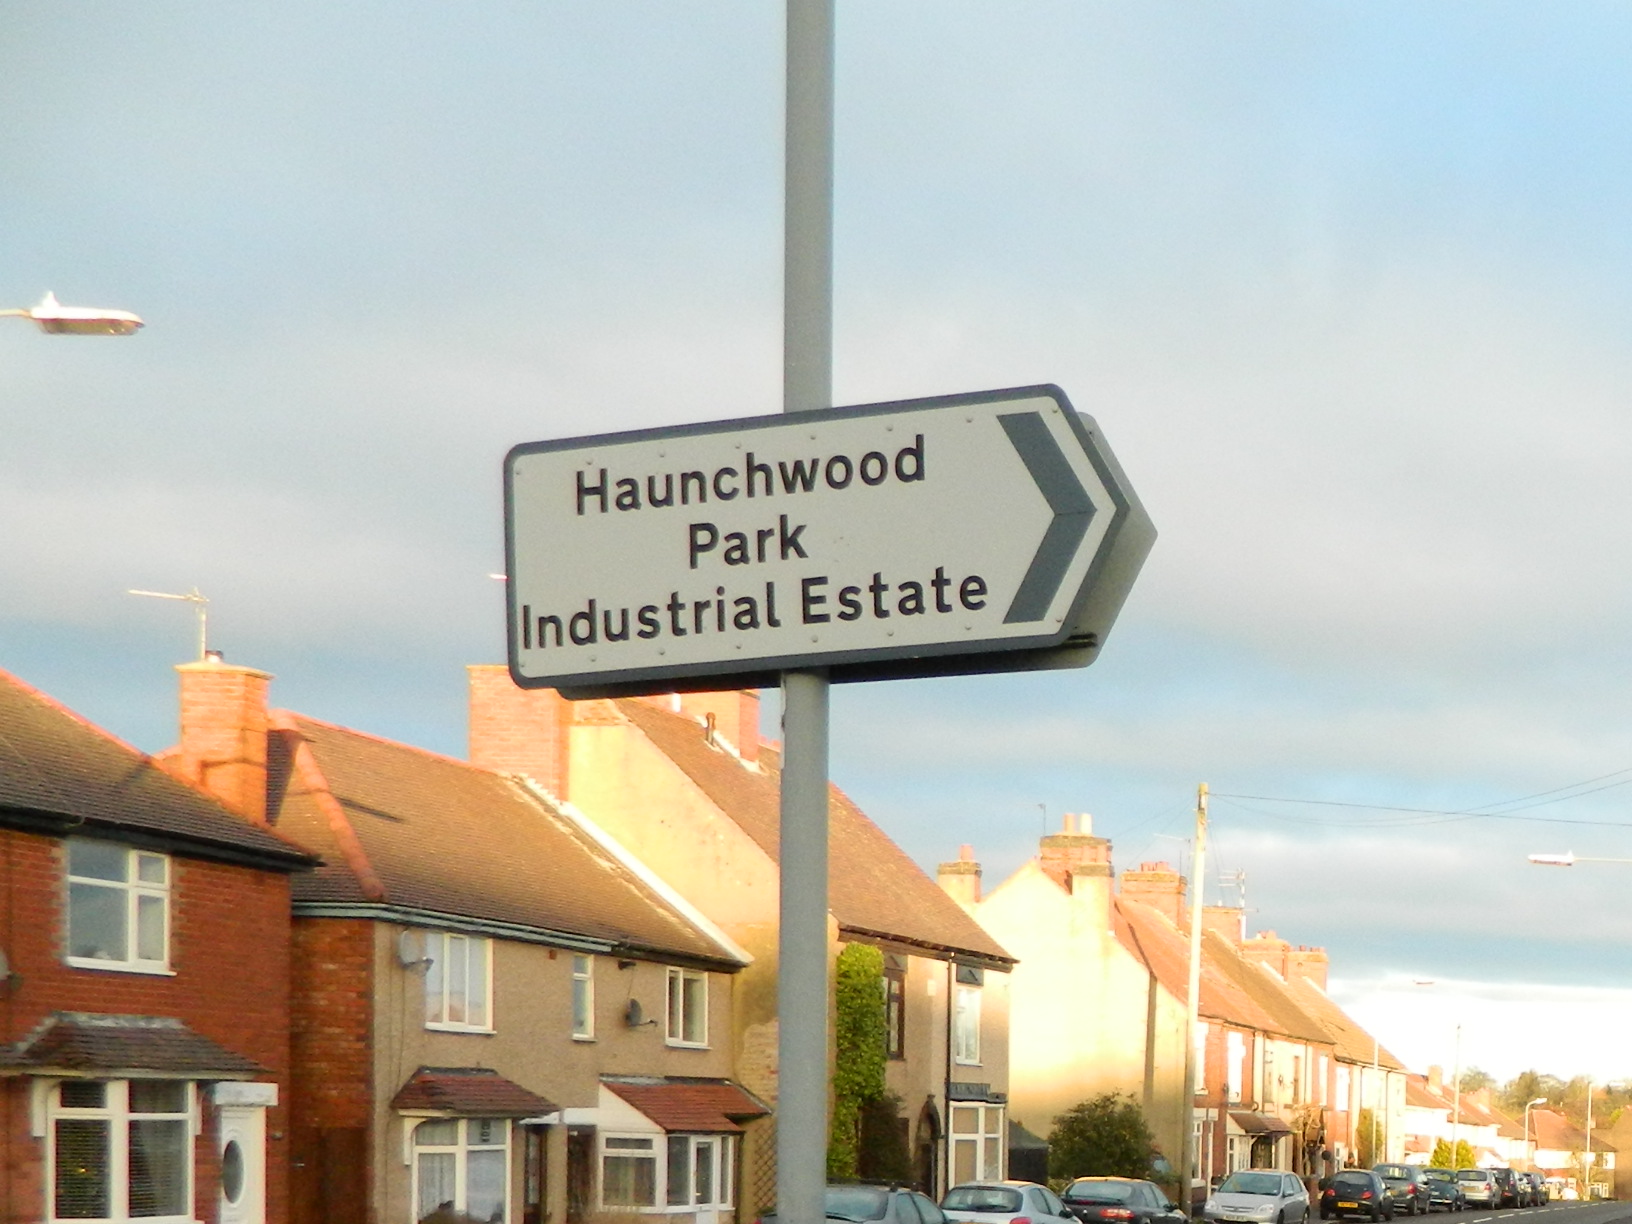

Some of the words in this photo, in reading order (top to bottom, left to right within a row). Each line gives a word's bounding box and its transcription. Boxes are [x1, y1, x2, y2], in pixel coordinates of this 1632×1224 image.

[575, 433, 926, 517] Haunchwood
[688, 514, 809, 570] Park
[521, 581, 782, 650] Industrial
[800, 566, 988, 625] Estate
